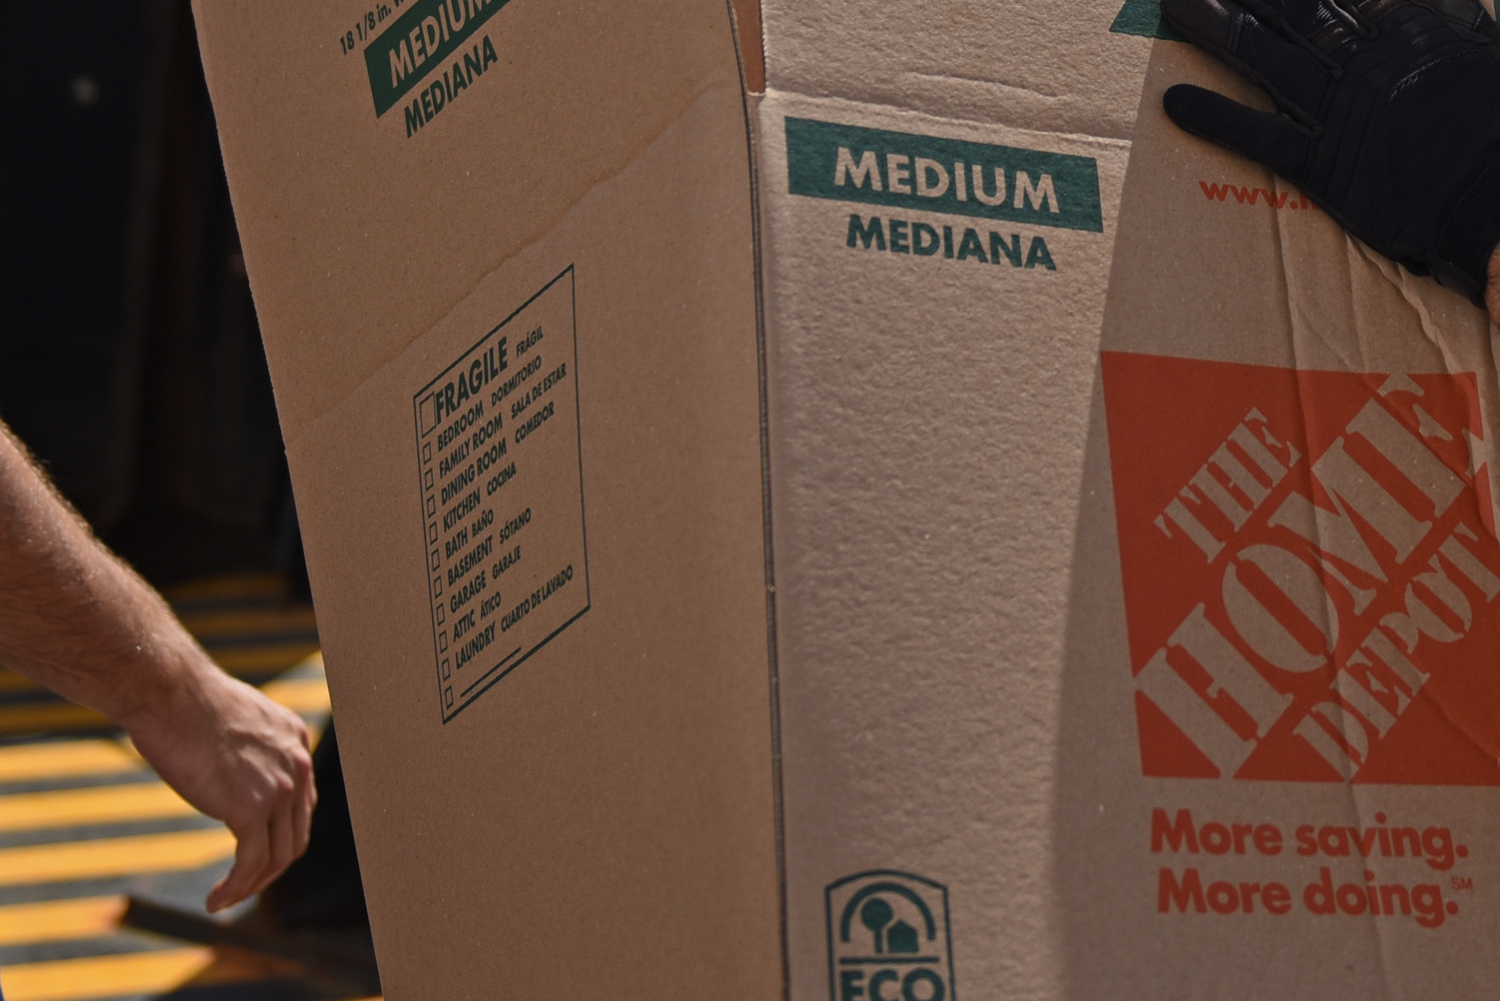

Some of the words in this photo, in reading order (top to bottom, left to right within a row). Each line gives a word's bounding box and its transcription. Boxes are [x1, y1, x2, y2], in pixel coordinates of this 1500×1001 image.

[339, 30, 355, 56] 18
[355, 10, 376, 42] 1/8
[376, 4, 392, 23] in.
[404, 34, 499, 139] MEDIANA
[833, 146, 1061, 214] MEDIUM
[846, 214, 1058, 272] MEDIANA
[435, 335, 508, 426] FRAGILE
[516, 325, 544, 359] FRÁGIL
[437, 400, 484, 453] BEDROOM
[491, 354, 542, 407] DORMITORIO
[439, 437, 471, 480] FAMILY
[472, 411, 503, 451] ROOM
[511, 392, 532, 420] SALA
[532, 382, 543, 401] DE
[543, 362, 567, 393] ESTAR
[441, 463, 476, 506] DINING
[476, 437, 507, 477] ROOM
[514, 400, 555, 445] COMEDOR
[443, 487, 481, 534] KITCHEN
[486, 461, 517, 497] COCINA
[1153, 406, 1301, 565] THE
[445, 525, 468, 560] BATH
[471, 508, 494, 539] BAÑO
[447, 534, 493, 587] BASEMENT
[499, 507, 532, 545] SÓTANO
[450, 570, 487, 614] GARAGE
[492, 545, 521, 580] GARAJE
[1132, 373, 1488, 780] HOME
[453, 608, 476, 642] ATTIC
[480, 590, 502, 621] ÁTICO
[455, 621, 496, 670] LAUNDRY
[501, 597, 530, 633] CUARTO
[530, 592, 541, 610] DE
[541, 564, 574, 600] LAVADO
[1150, 807, 1284, 857] More
[1295, 811, 1469, 871] saving.
[1157, 867, 1293, 915] More
[841, 968, 946, 1001] ECO
